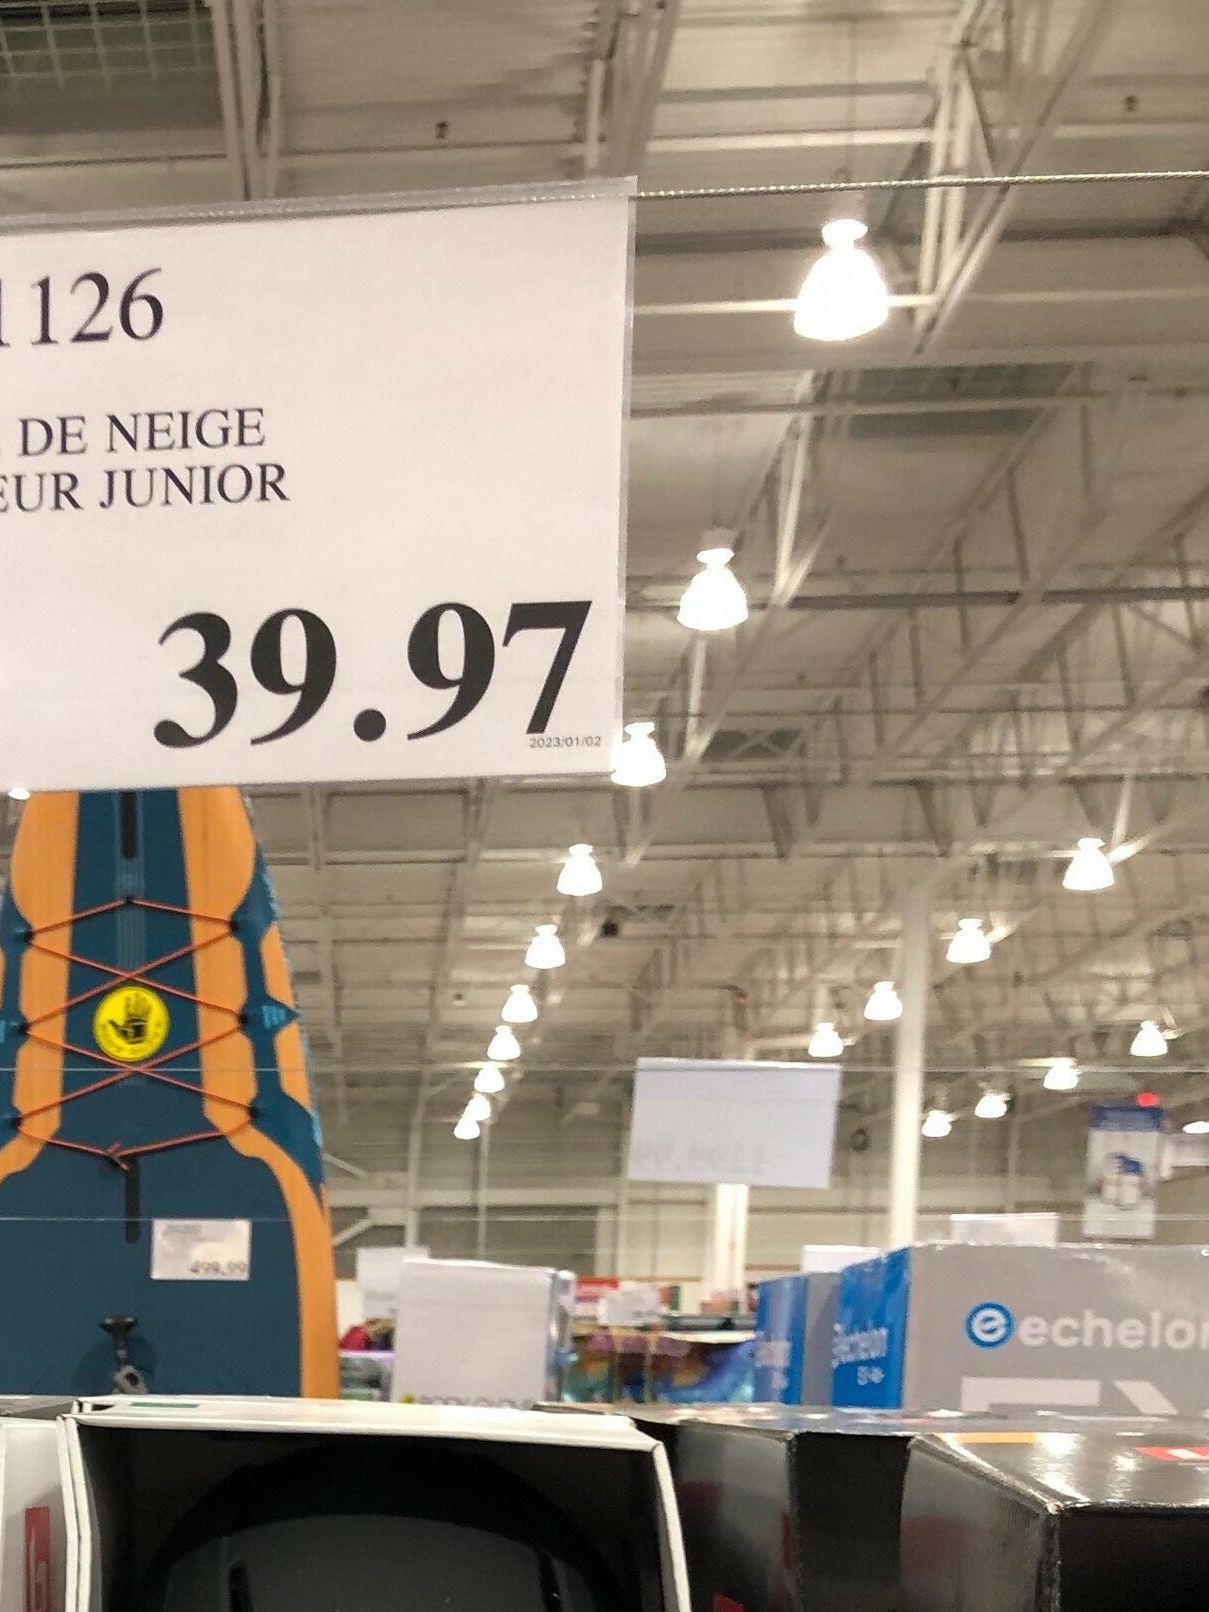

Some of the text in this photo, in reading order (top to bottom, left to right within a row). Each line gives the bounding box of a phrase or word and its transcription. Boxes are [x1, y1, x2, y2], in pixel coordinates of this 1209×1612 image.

[16, 415, 87, 458] DE
[104, 408, 266, 454] NEIGE
[98, 462, 290, 512] JUNIOR
[151, 600, 594, 751] 39.97
[528, 735, 603, 751] 2023/01/02
